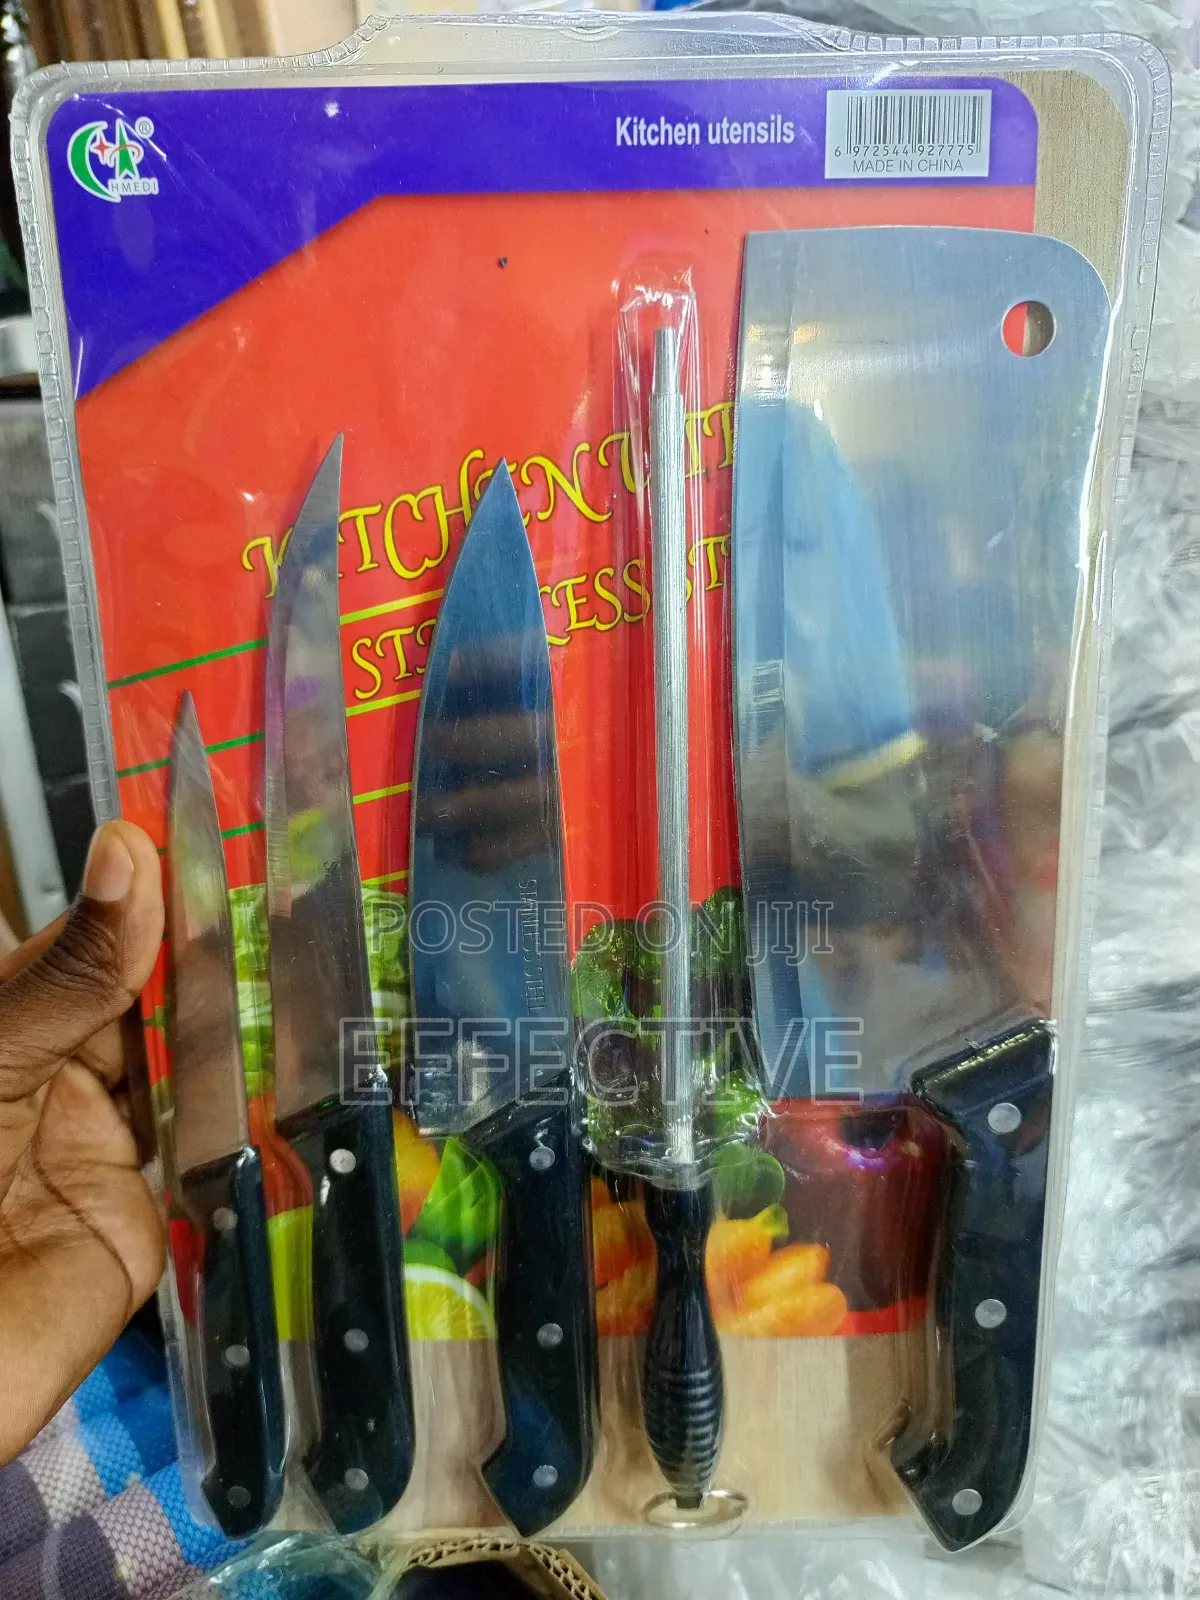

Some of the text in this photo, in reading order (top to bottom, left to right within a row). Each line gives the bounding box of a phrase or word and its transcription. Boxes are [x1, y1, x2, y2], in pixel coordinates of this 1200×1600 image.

[616, 114, 795, 146] Kitchen utensils
[834, 144, 974, 157] 6 972544 927775
[852, 158, 964, 173] MADE IN CHINA
[241, 448, 612, 598] KTCHN
